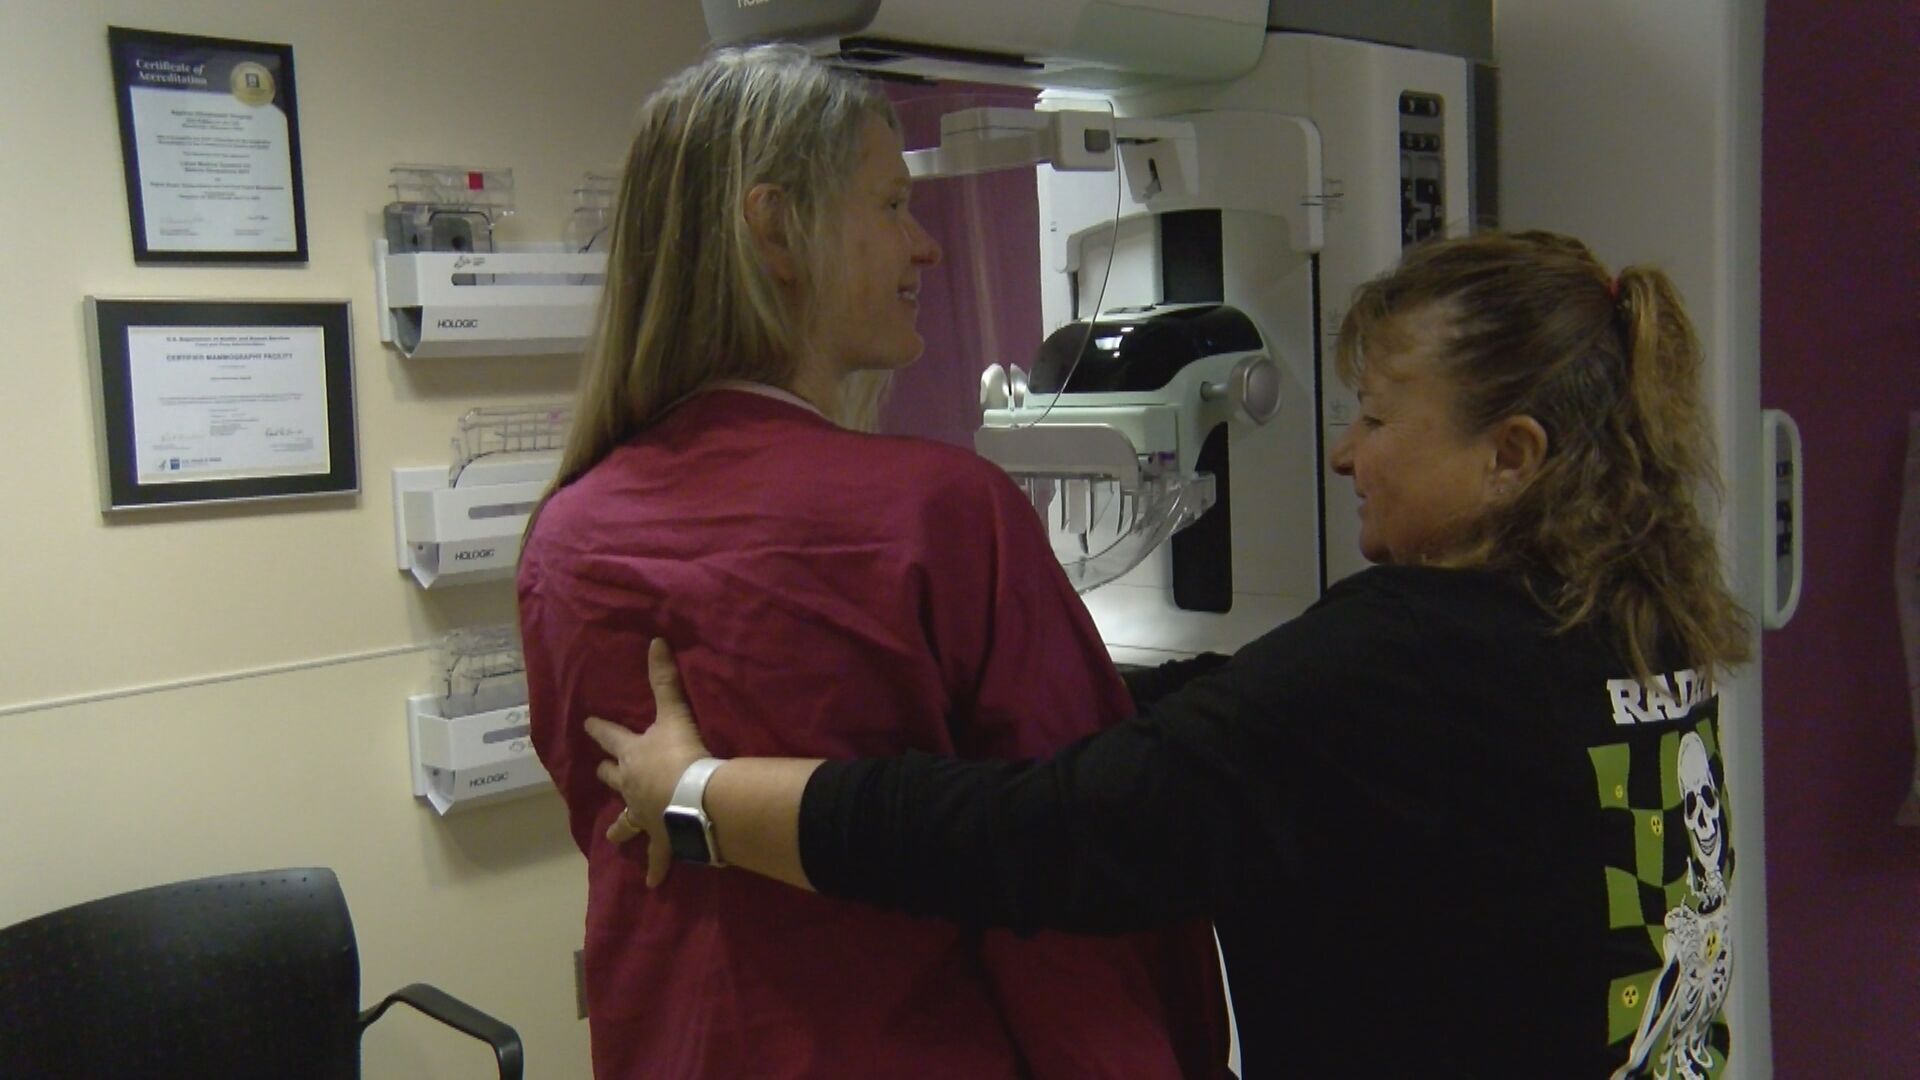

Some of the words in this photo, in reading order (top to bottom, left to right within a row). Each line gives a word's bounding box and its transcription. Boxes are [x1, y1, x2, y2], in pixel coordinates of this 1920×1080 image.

[136, 58, 190, 73] Certificate
[193, 64, 206, 76] of
[138, 70, 208, 85] Accreditation
[437, 319, 479, 329] HOLOGIC
[206, 353, 262, 361] MAMMOGRAPHY
[263, 352, 293, 360] FACILITY
[454, 548, 496, 561] HOLOGIC
[468, 771, 509, 788] HOLOGIC
